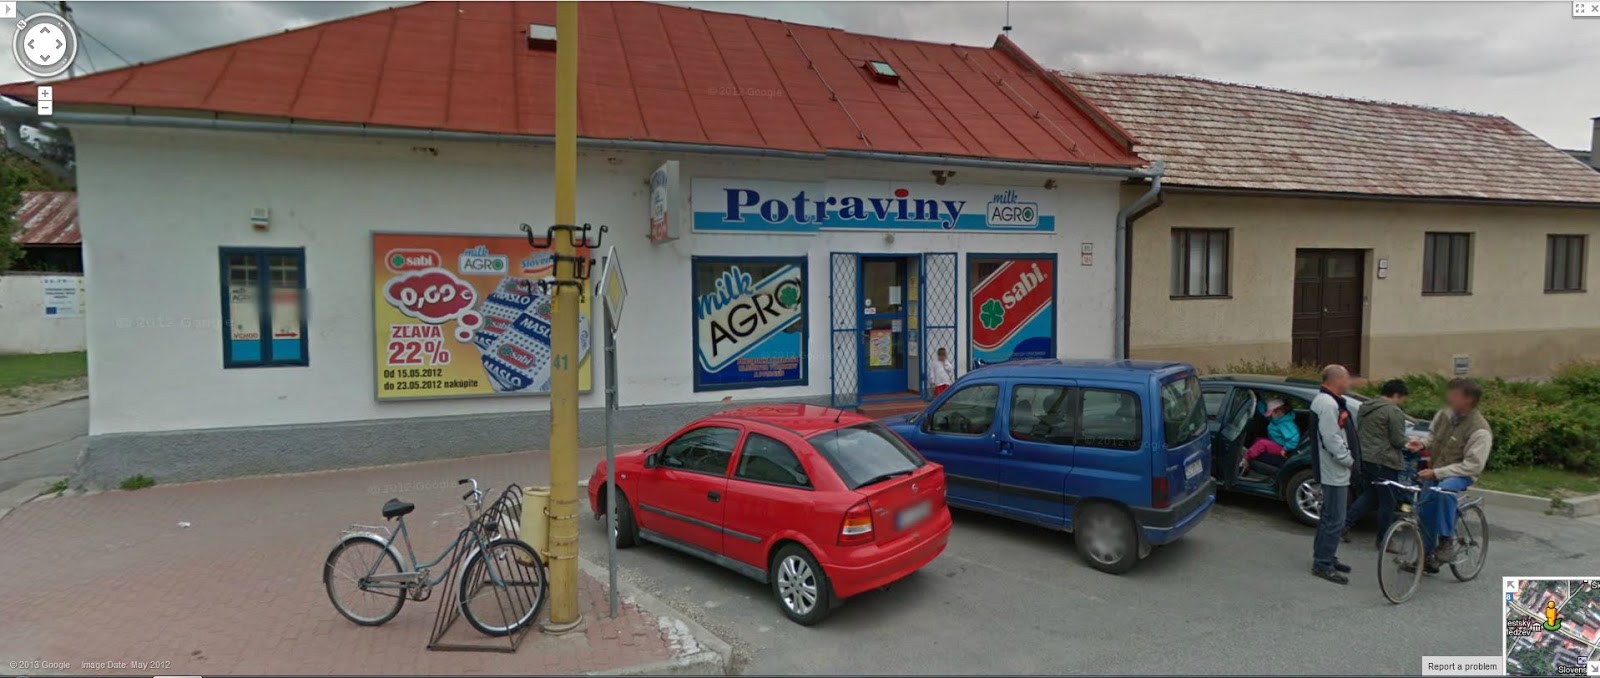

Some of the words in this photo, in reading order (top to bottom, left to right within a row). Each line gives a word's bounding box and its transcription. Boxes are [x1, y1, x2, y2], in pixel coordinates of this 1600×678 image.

[993, 189, 1018, 204] milk
[723, 187, 966, 230] Potraviny
[991, 206, 1035, 223] AGRO
[464, 245, 489, 257] milk
[406, 255, 433, 266] sabi
[464, 258, 504, 271] AGRO
[698, 265, 752, 319] milk
[710, 277, 802, 358] AGRO
[520, 318, 551, 338] MASL
[388, 340, 450, 365] 22%
[553, 353, 569, 370] 41
[383, 369, 395, 379] Od
[397, 368, 443, 379] 15.05.2012
[483, 360, 522, 388] MASLO
[383, 381, 395, 391] do
[396, 380, 442, 390] 23.05.2012
